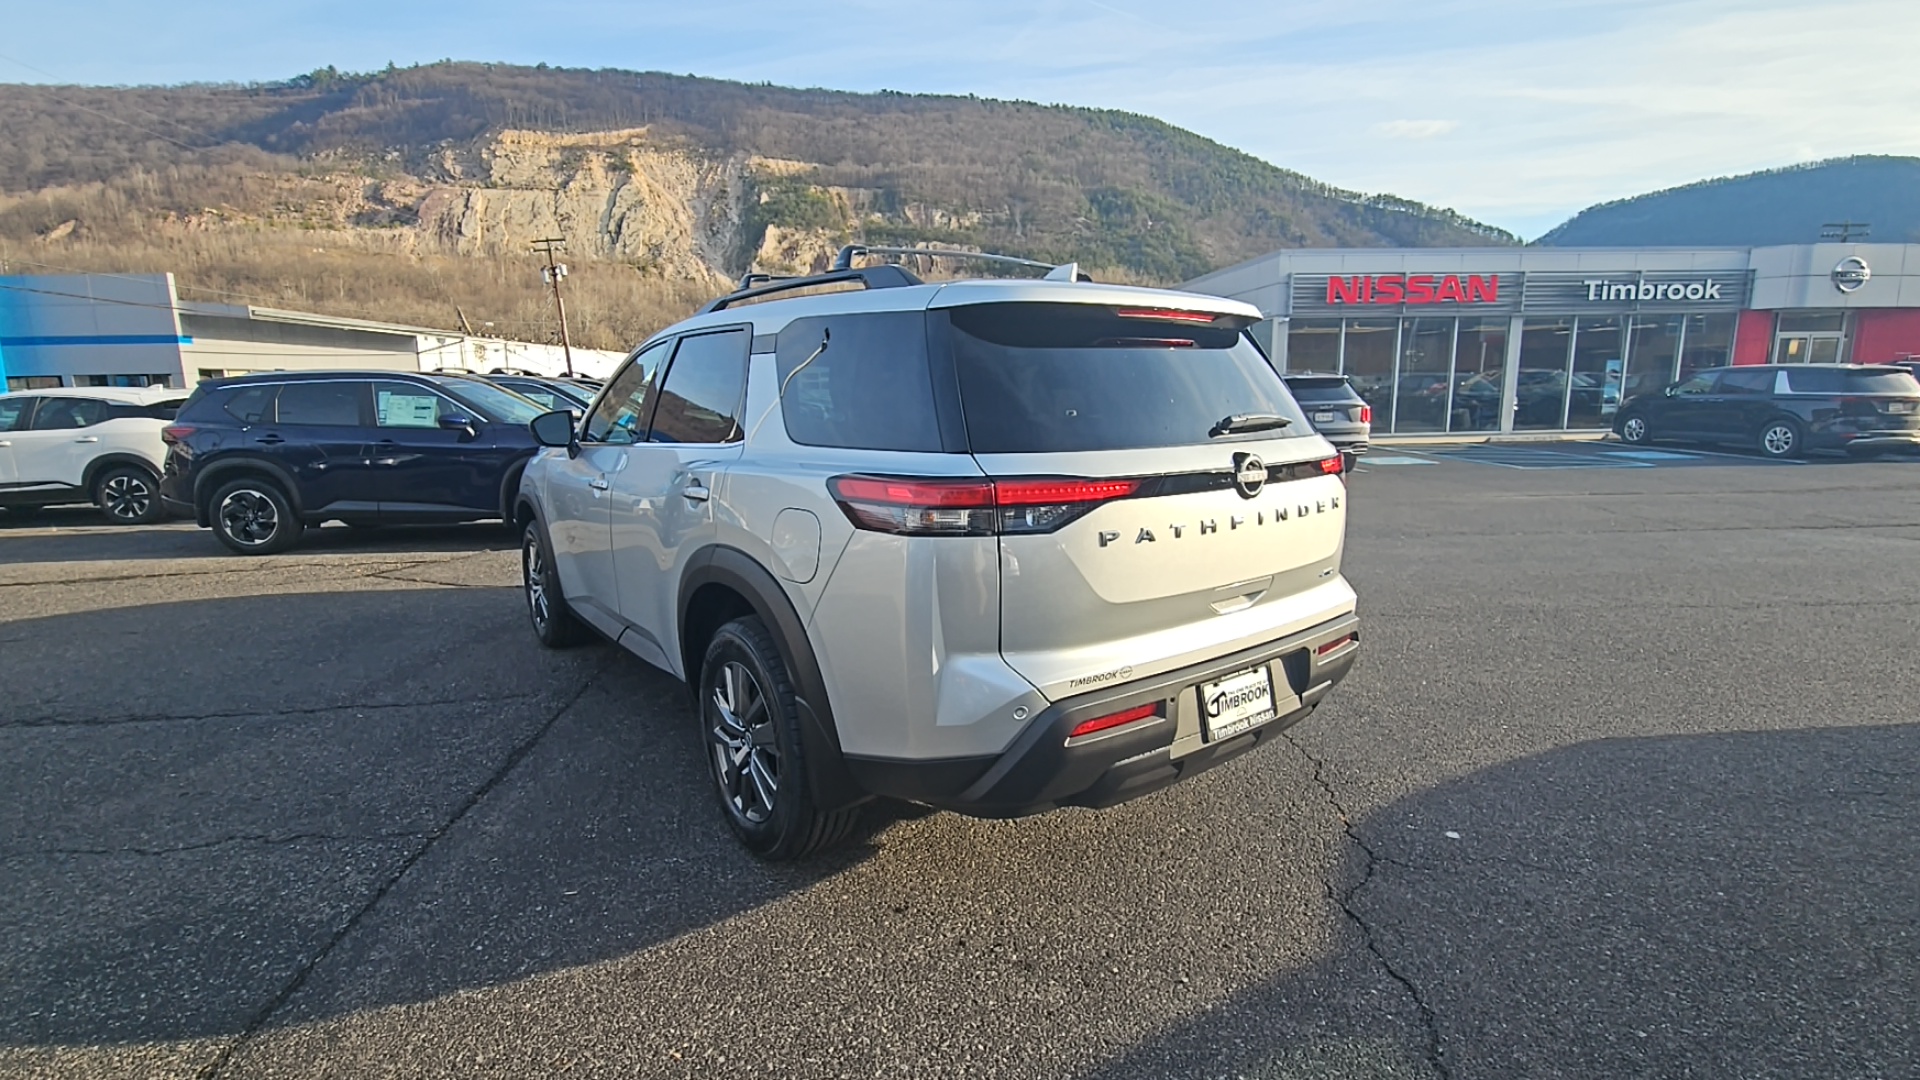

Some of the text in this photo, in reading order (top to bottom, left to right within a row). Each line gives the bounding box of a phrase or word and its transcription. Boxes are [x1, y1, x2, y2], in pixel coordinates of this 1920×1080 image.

[1327, 274, 1498, 305] NISSAN
[1584, 278, 1721, 300] Timbrook
[1098, 497, 1340, 548] PATHFINDER
[1069, 669, 1119, 688] TIMBROOK
[1207, 684, 1269, 718] TIMBROOK
[1213, 718, 1250, 740] Timbrook
[1249, 709, 1275, 726] Nissan
